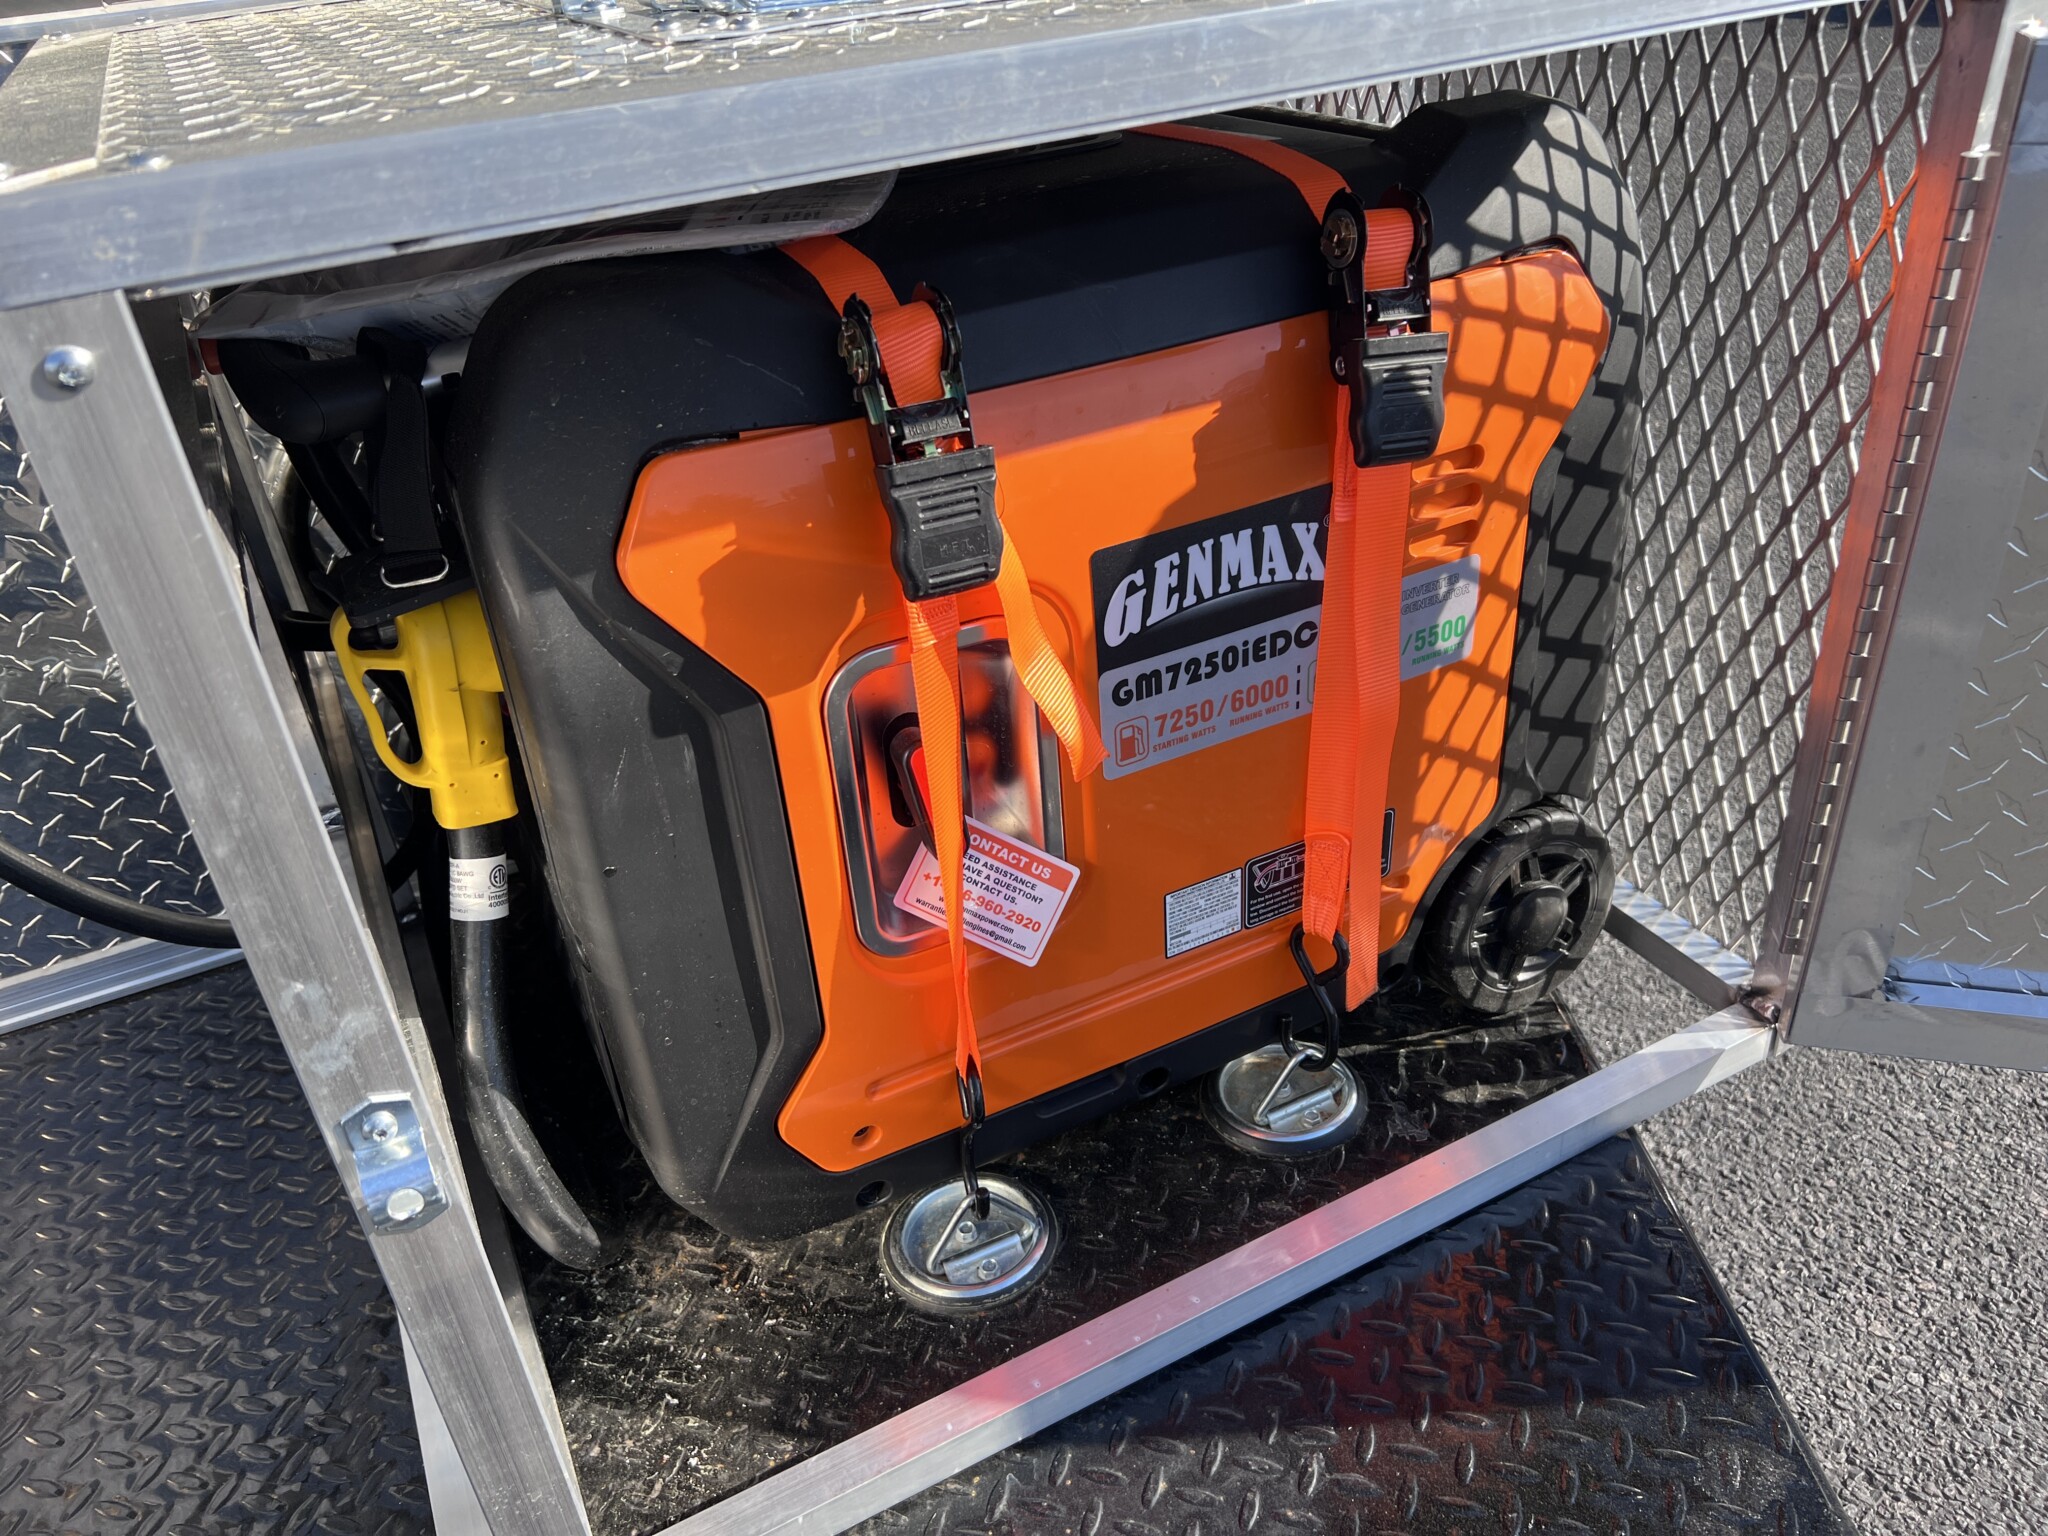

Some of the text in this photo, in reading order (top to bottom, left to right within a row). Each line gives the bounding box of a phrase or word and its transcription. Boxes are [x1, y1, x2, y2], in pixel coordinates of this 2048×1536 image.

[1103, 522, 1326, 648] GENMAX
[1401, 573, 1460, 602] INVERTER
[1401, 583, 1470, 616] GENERATOR
[1111, 620, 1318, 707] GM7250iEDC
[1411, 649, 1442, 666] RUNNING
[1154, 674, 1289, 738] 7250/6000
[1229, 701, 1290, 728] RUNNING WATTS
[1152, 725, 1217, 753] STARTING WATTS
[963, 852, 1038, 892] EED ASSISTANCE
[969, 833, 1053, 880] ONTACT US
[984, 873, 991, 882] A
[993, 877, 1044, 905] QUESTION?
[1003, 893, 1018, 906] US.
